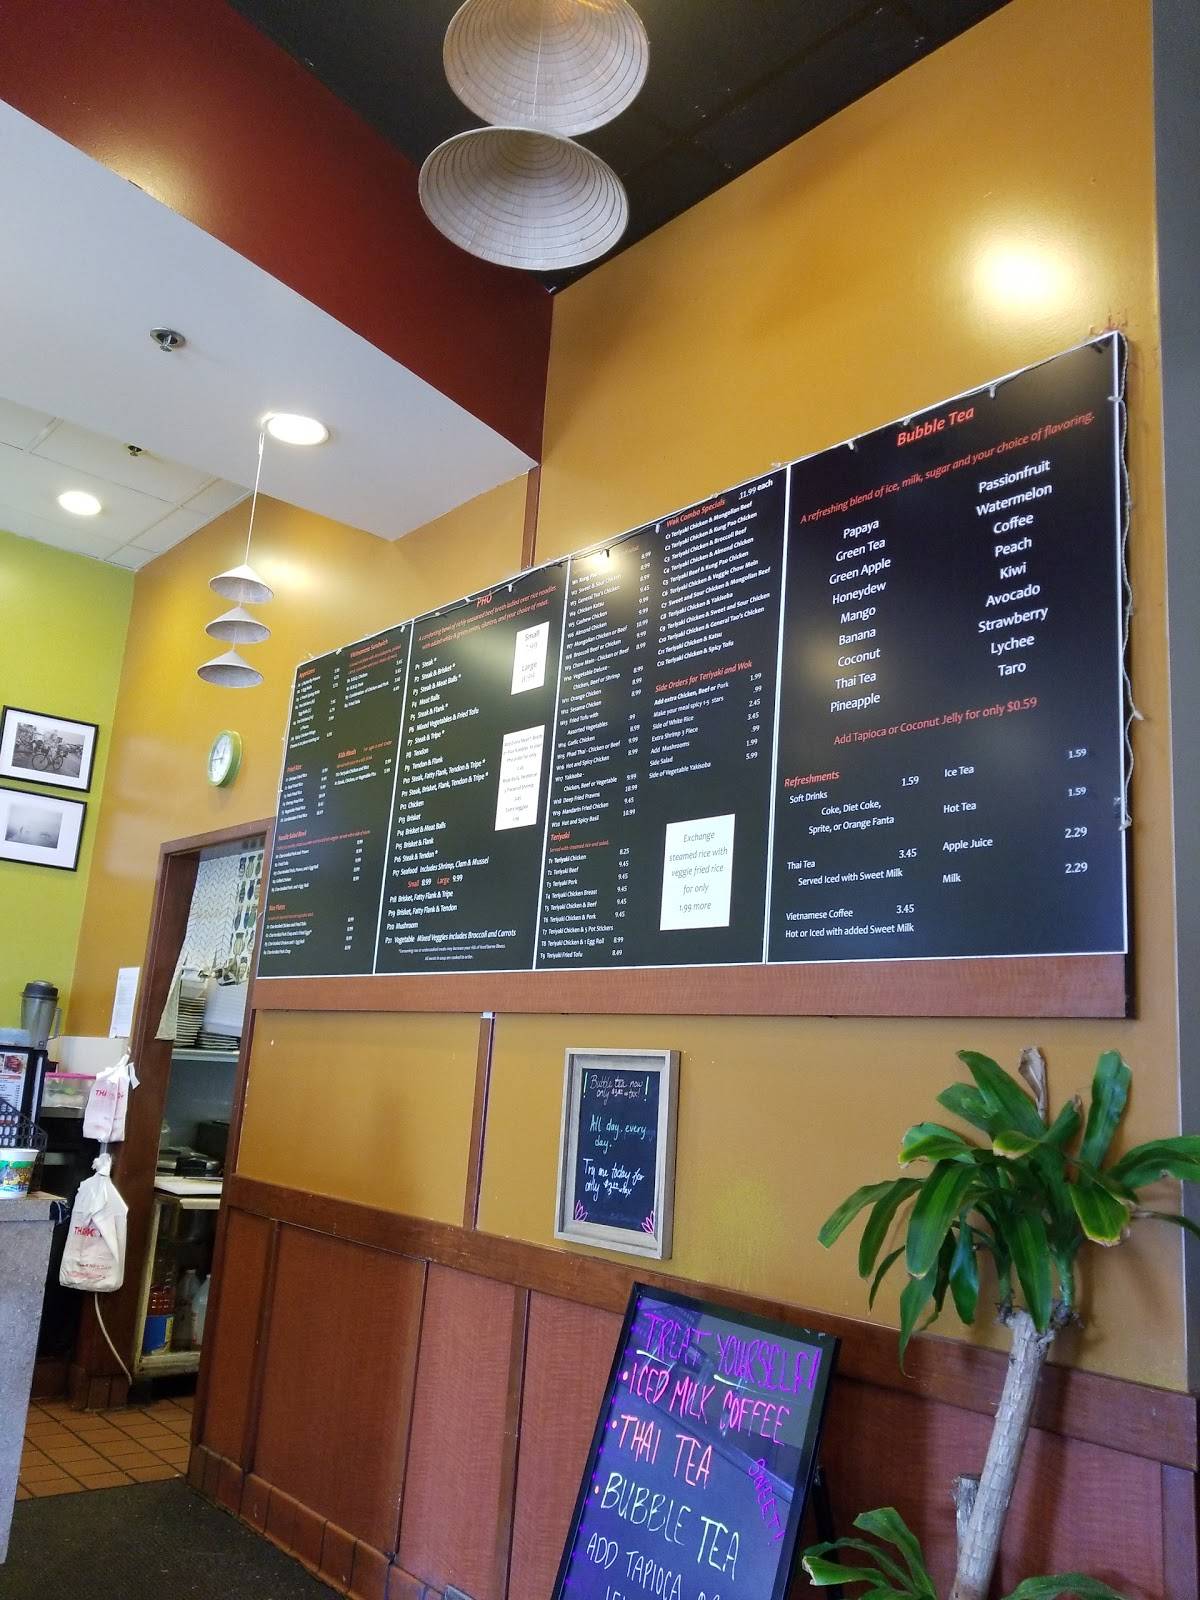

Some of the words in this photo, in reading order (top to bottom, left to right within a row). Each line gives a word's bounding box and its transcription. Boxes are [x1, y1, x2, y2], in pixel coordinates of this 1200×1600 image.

[893, 419, 945, 447] Bubble
[948, 407, 973, 425] Tea
[800, 515, 808, 524] A
[808, 500, 849, 521] refreshing
[849, 489, 873, 506] blend
[874, 485, 885, 497] of
[885, 483, 900, 493] ice,
[902, 473, 923, 487] milk,
[925, 463, 952, 479] sugar
[952, 454, 971, 469] and
[970, 447, 995, 464] your
[996, 435, 1031, 453] choice
[1030, 428, 1044, 440] of
[1044, 412, 1094, 438] flavoring.
[978, 460, 1050, 493] Passionfruit
[976, 485, 1052, 516] Watermelon
[843, 520, 879, 538] Papaya
[993, 514, 1033, 533] Coffee
[836, 546, 865, 561] Green
[867, 539, 885, 551] Tea
[995, 537, 1032, 557] Peach
[829, 569, 858, 584] Green
[860, 558, 891, 575] Apple
[1000, 561, 1026, 579] Kiwi
[832, 582, 886, 604] Honeydew
[985, 584, 1040, 607] Avocado
[840, 607, 876, 623] Mango
[978, 607, 1048, 632] Strawberry
[839, 629, 876, 645] Banana
[991, 636, 1034, 655] Lychee
[838, 648, 880, 666] Coconut
[655, 683, 667, 692] Side
[667, 678, 688, 689] Orders
[688, 676, 698, 685] for
[700, 669, 723, 680] Teriyaki
[724, 664, 736, 674] and
[738, 661, 752, 670] Wok
[997, 662, 1026, 676] Taro
[835, 675, 856, 689] Thai
[858, 673, 876, 683] Tea
[830, 693, 880, 712] Pineapple
[833, 733, 851, 744] Add
[852, 728, 887, 742] Tapioca
[888, 726, 898, 734] or
[899, 717, 939, 732] Coconut
[941, 712, 963, 724] Jelly
[965, 709, 980, 719] for
[982, 704, 1005, 716] only
[1007, 697, 1037, 712] $0.59
[660, 756, 673, 764] Salad
[1069, 748, 1086, 758] 1.59
[784, 771, 839, 787] Refreshments
[944, 769, 957, 777] Ice
[958, 766, 974, 774] Tea
[902, 776, 919, 786] 1.59
[789, 793, 804, 803] Soft
[805, 791, 827, 801] Drinks
[1068, 786, 1086, 796] 1.59
[821, 806, 841, 815] Coke,
[843, 803, 858, 812] Diet
[859, 800, 881, 810] Coke,
[943, 804, 959, 813] Hot
[961, 802, 976, 810] Tea
[809, 824, 832, 835] Sprite,
[843, 820, 871, 829] Orange
[872, 816, 894, 825] Fanta
[1065, 826, 1087, 838] 2.29
[683, 832, 715, 843] Exchange
[942, 840, 968, 852] Apple
[970, 838, 993, 848] Juice
[669, 850, 697, 861] steamed
[712, 845, 727, 856] with
[899, 848, 917, 858] 3.45
[672, 867, 692, 878] veggie
[693, 864, 710, 876] fried
[711, 863, 723, 872] rice
[787, 860, 802, 869] Thai
[803, 860, 815, 868] Tea
[1065, 862, 1087, 873] 2.29
[798, 875, 822, 886] Served
[824, 873, 840, 883] Iced
[841, 872, 858, 881] with
[859, 870, 884, 880] Sweet
[885, 868, 903, 877] Milk
[942, 873, 961, 883] Milk
[683, 884, 693, 895] for
[694, 882, 709, 893] only
[786, 912, 827, 920] Vietnamese
[828, 908, 853, 918] Coffee
[896, 904, 914, 913] 3.45
[809, 927, 824, 936] Iced
[826, 926, 843, 935] with
[844, 925, 868, 935] added
[870, 925, 895, 933] Sweet
[897, 922, 914, 932] Milk
[629, 1363, 670, 1404] ICED
[670, 1375, 716, 1424] MILK
[720, 1391, 790, 1448] COFFEE
[619, 1414, 662, 1466] THAI
[673, 1434, 712, 1490] TEA
[600, 1472, 692, 1546] BUBBLE
[697, 1515, 740, 1582] TEA
[587, 1532, 618, 1570] ADD
[626, 1551, 682, 1600] TAPIOCA
